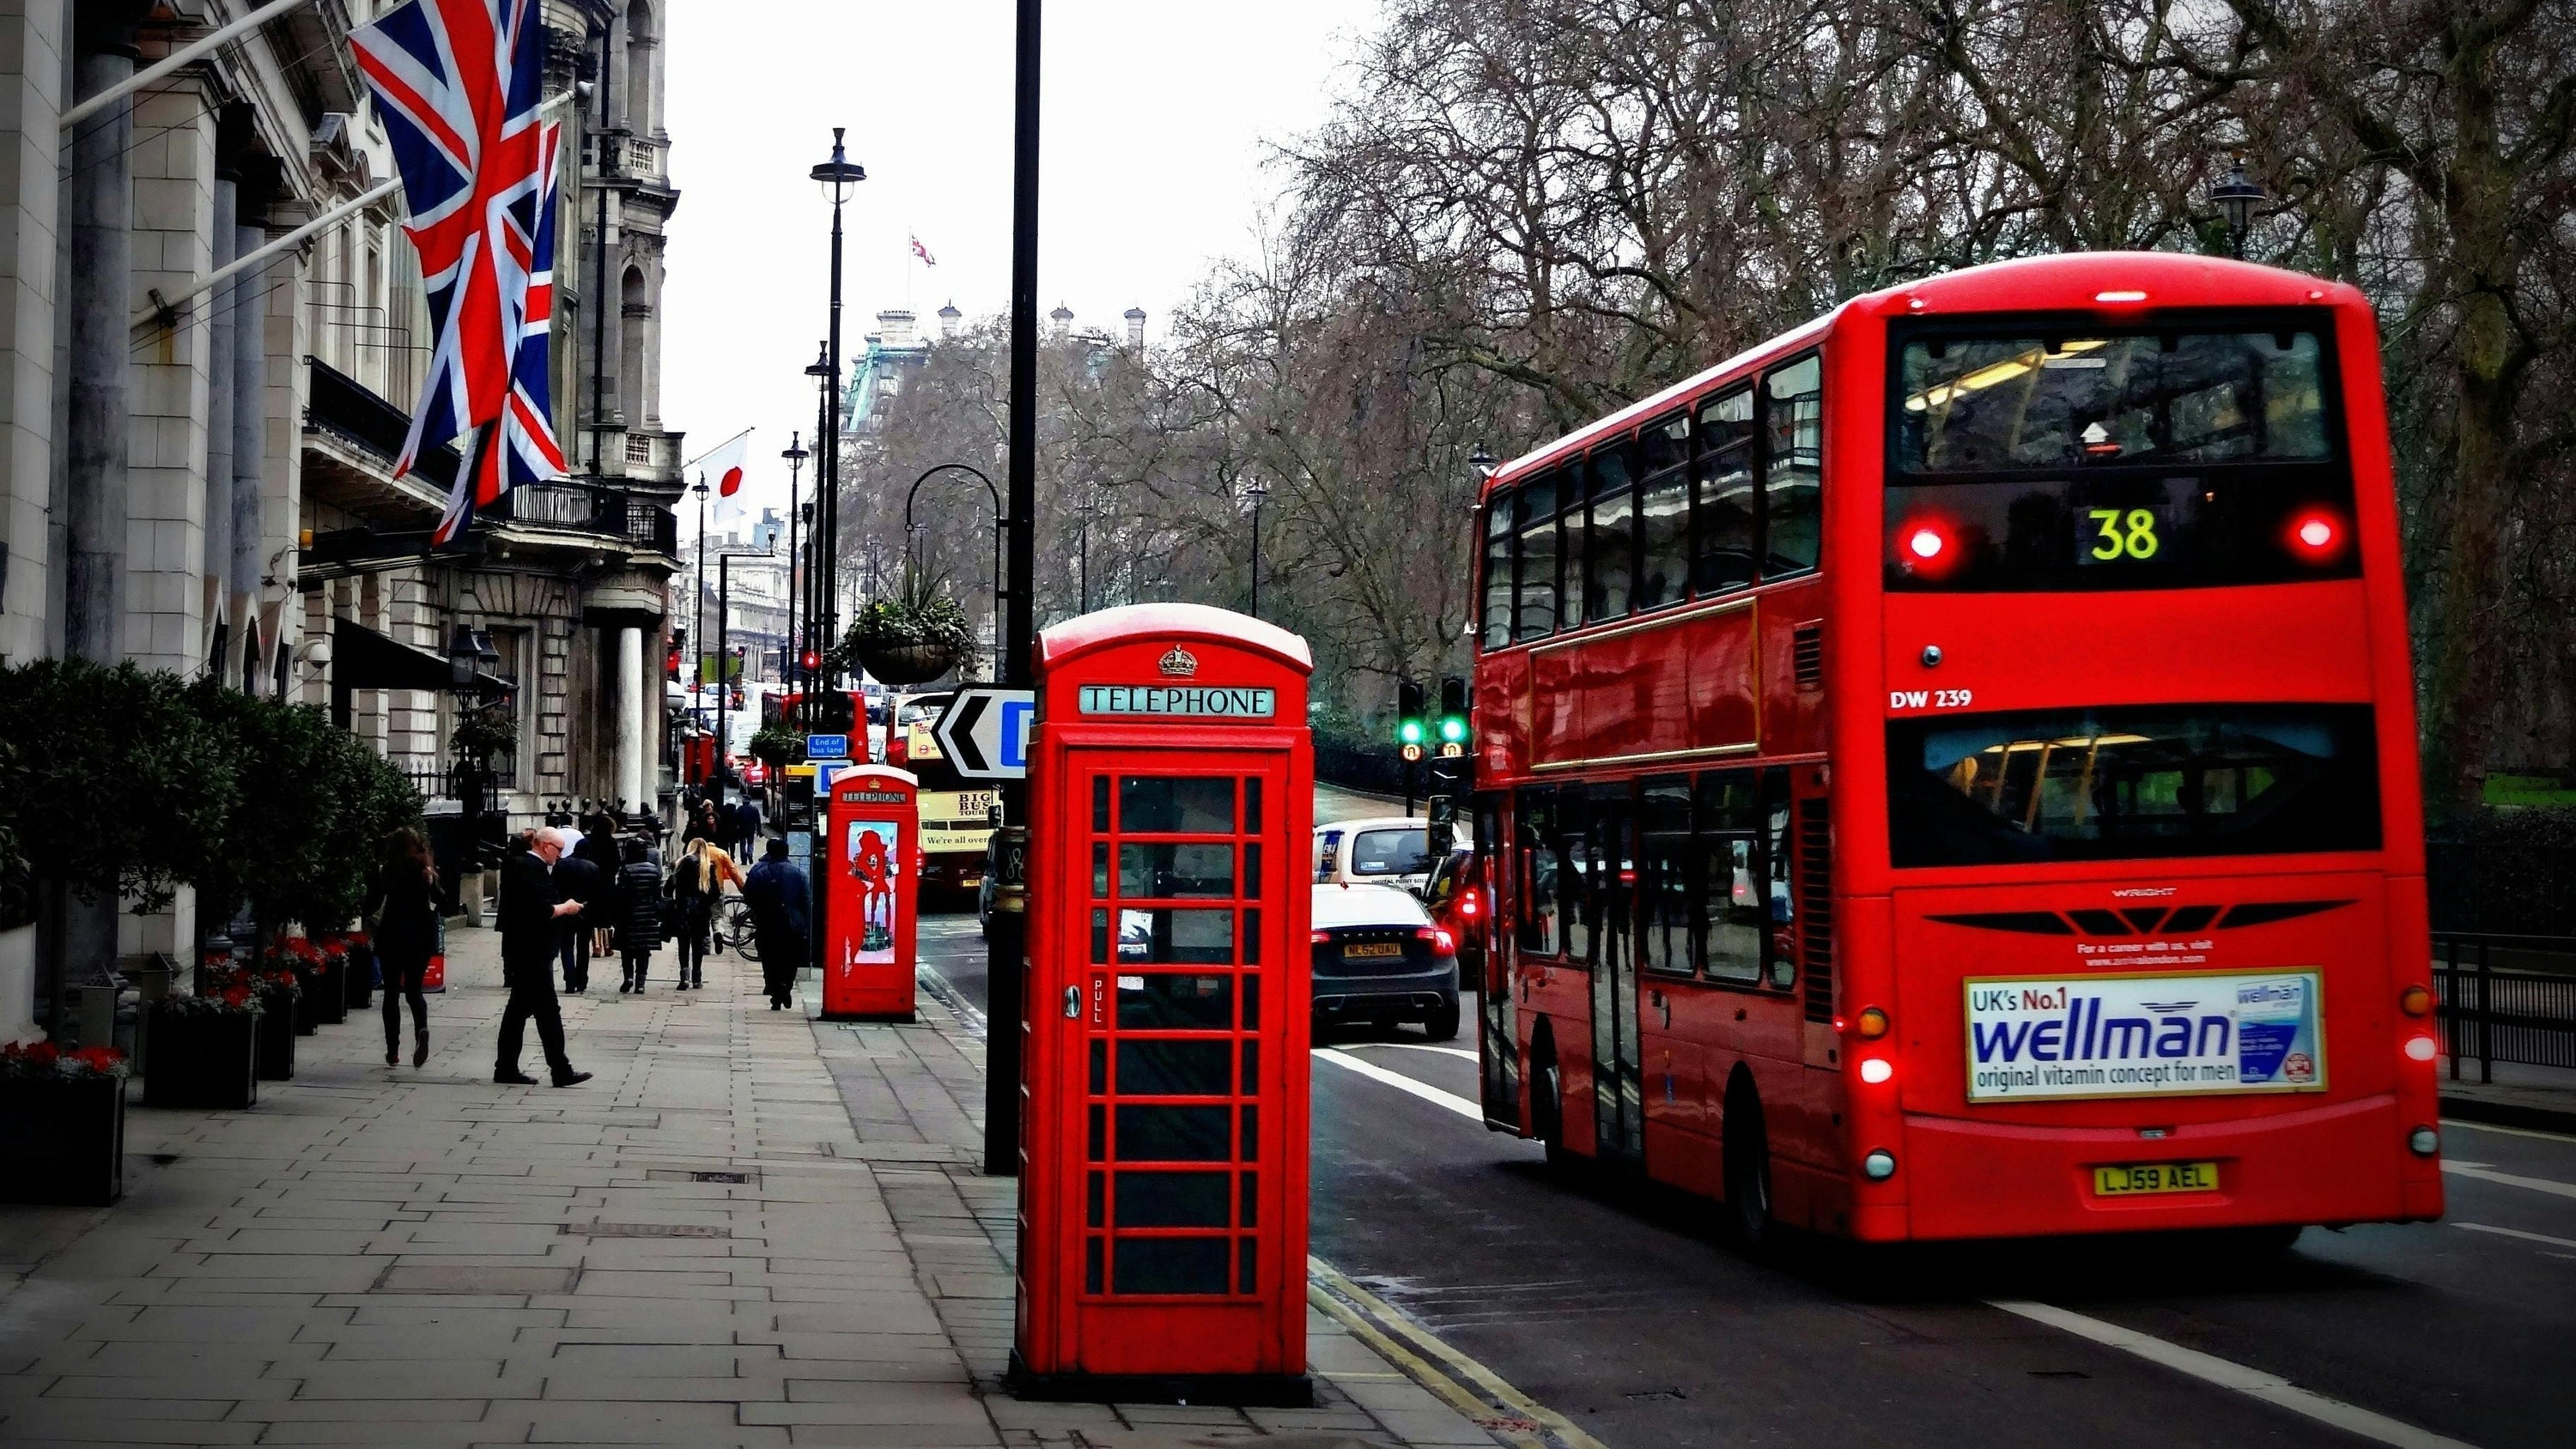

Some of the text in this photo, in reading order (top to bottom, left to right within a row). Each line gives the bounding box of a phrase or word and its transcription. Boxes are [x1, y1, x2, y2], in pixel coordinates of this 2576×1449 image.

[2088, 508, 2159, 561] 38
[1085, 687, 1267, 714] TELEPHONE
[1890, 688, 1973, 709] DW 239
[844, 792, 904, 802] TELEPHONE
[959, 793, 990, 802] BIG
[959, 802, 990, 810] BUS
[927, 836, 952, 845] We're
[2112, 888, 2177, 897] WRIGHT
[2077, 944, 2095, 954] For
[2108, 943, 2144, 953] career
[2147, 941, 2169, 951] with
[1094, 979, 1103, 1022] PULL
[1973, 987, 2068, 1011] UK's No.1
[1972, 997, 2230, 1063] wellman
[1978, 1060, 2236, 1092] original vitamin concept for men
[2104, 1167, 2209, 1191] LJ59 AEL
